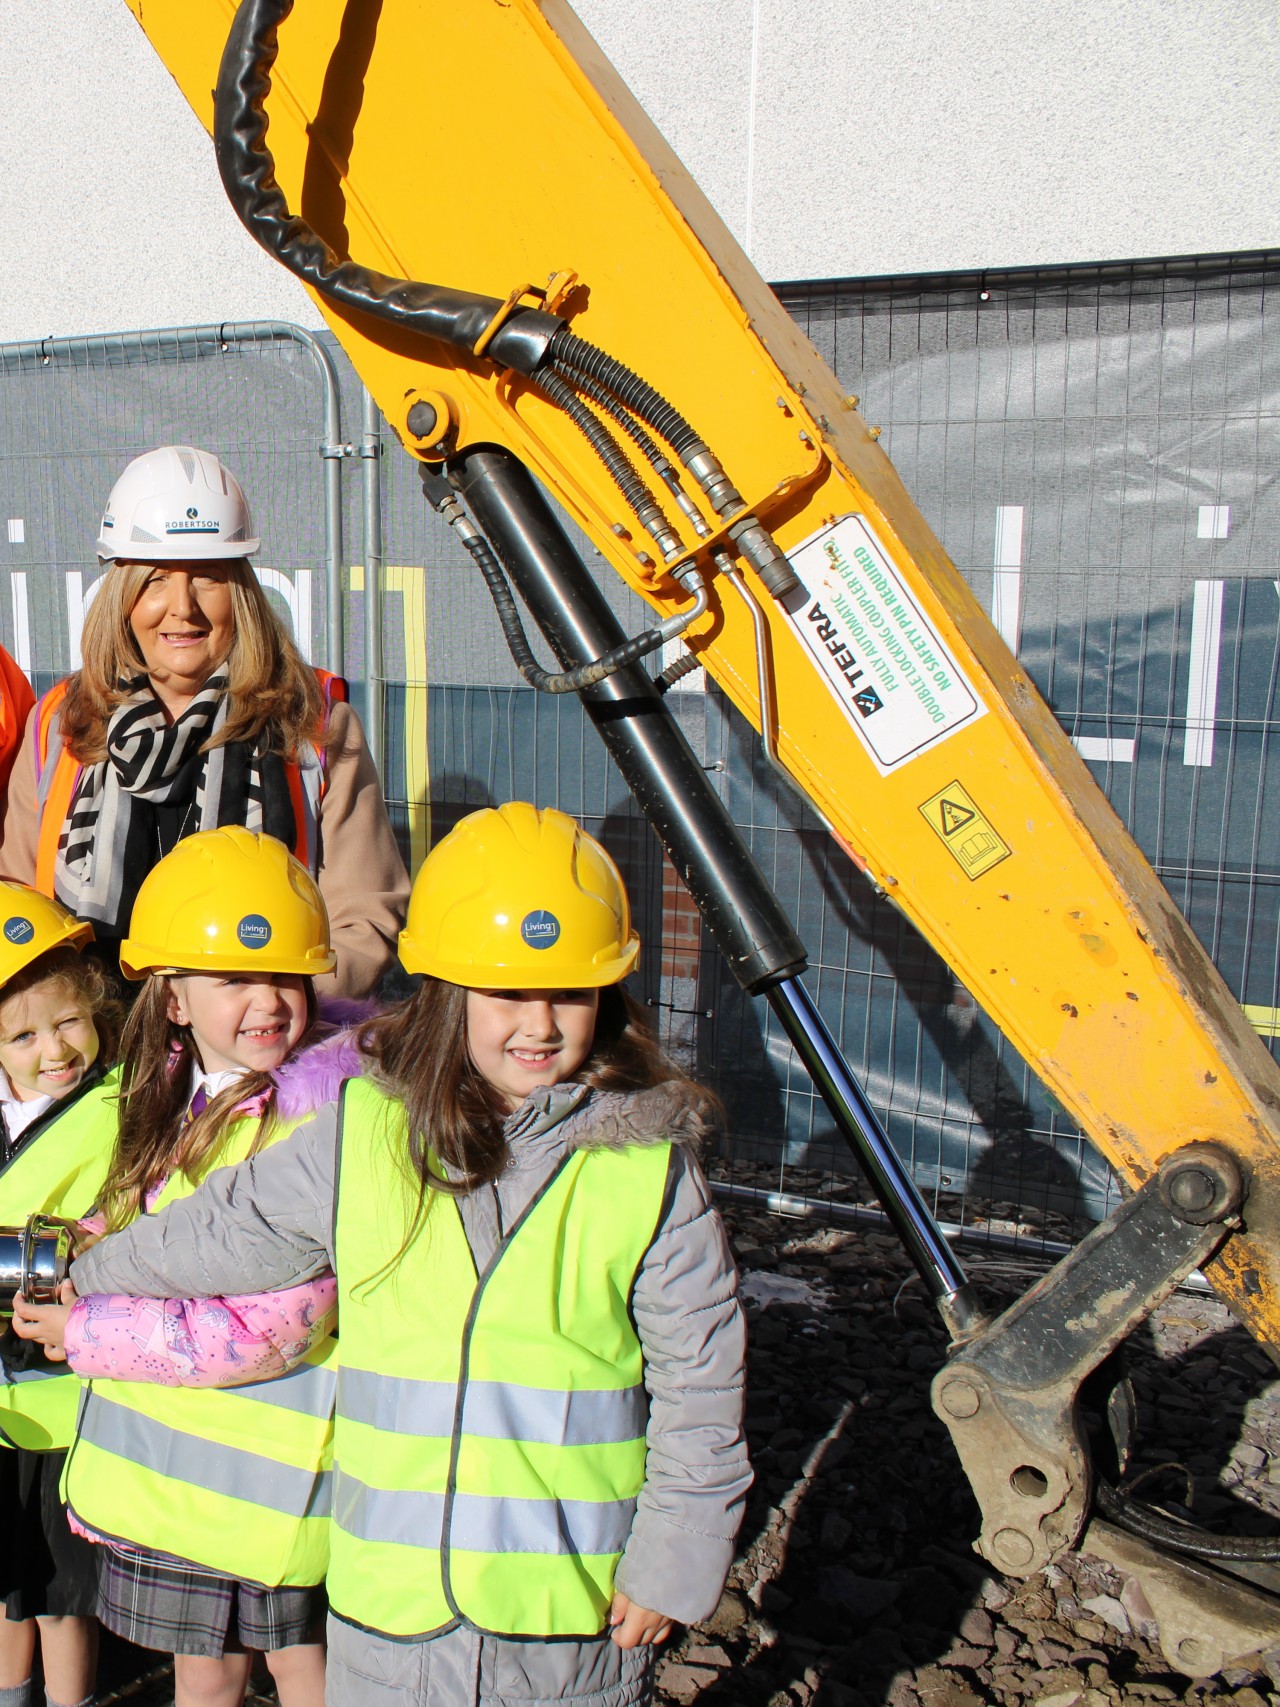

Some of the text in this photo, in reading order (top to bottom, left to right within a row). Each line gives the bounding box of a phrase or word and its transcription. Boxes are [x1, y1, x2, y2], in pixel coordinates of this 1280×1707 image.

[165, 520, 220, 528] ROBERTSON
[847, 577, 885, 628] COUPLER
[853, 547, 952, 691] NO SAFETY PIN REQUIRED
[807, 602, 863, 688] TEFRA
[831, 593, 899, 692] FULLY AUTOMATIC
[878, 627, 917, 679] LOCKING
[905, 676, 945, 723] DOUBLE
[6, 922, 26, 937] Living
[240, 923, 264, 934] Living
[524, 922, 551, 932] Living
